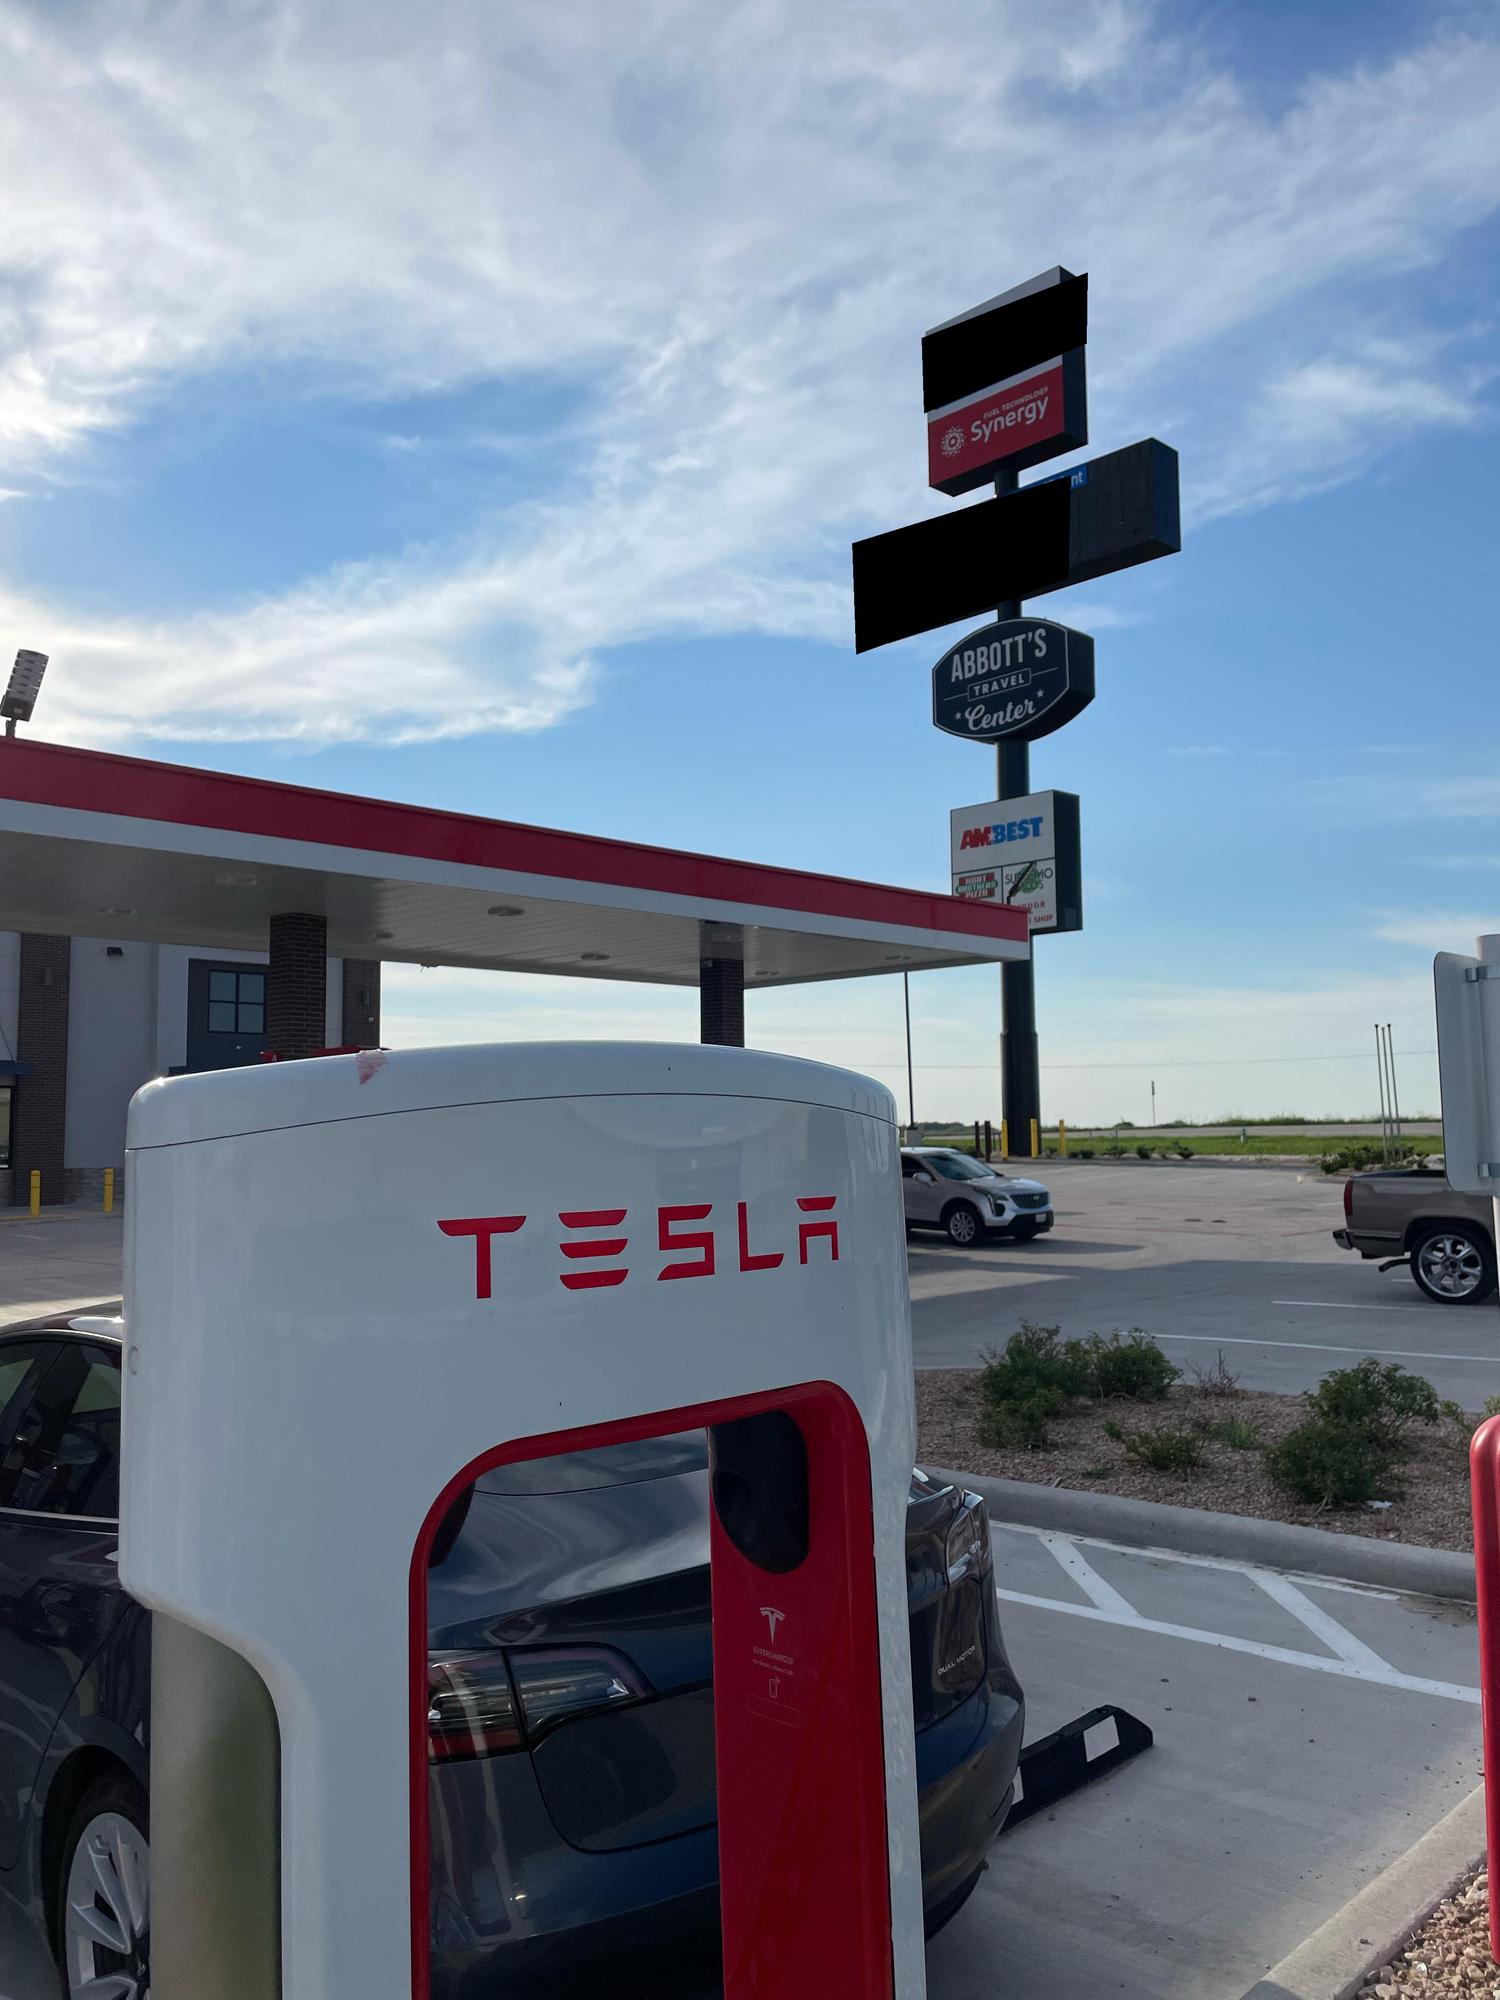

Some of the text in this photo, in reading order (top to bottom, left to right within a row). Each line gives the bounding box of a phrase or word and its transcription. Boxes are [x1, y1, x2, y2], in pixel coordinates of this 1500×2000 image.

[983, 387, 1048, 419] FUEL TECHNOLOGY
[971, 396, 1048, 443] Synergy
[951, 628, 1047, 682] ABBOTT'S
[973, 674, 1024, 696] TRAVEL
[964, 699, 1036, 731] Center
[437, 1195, 839, 1299] TESLA
[937, 1645, 976, 1676] DUAL MOTOR
